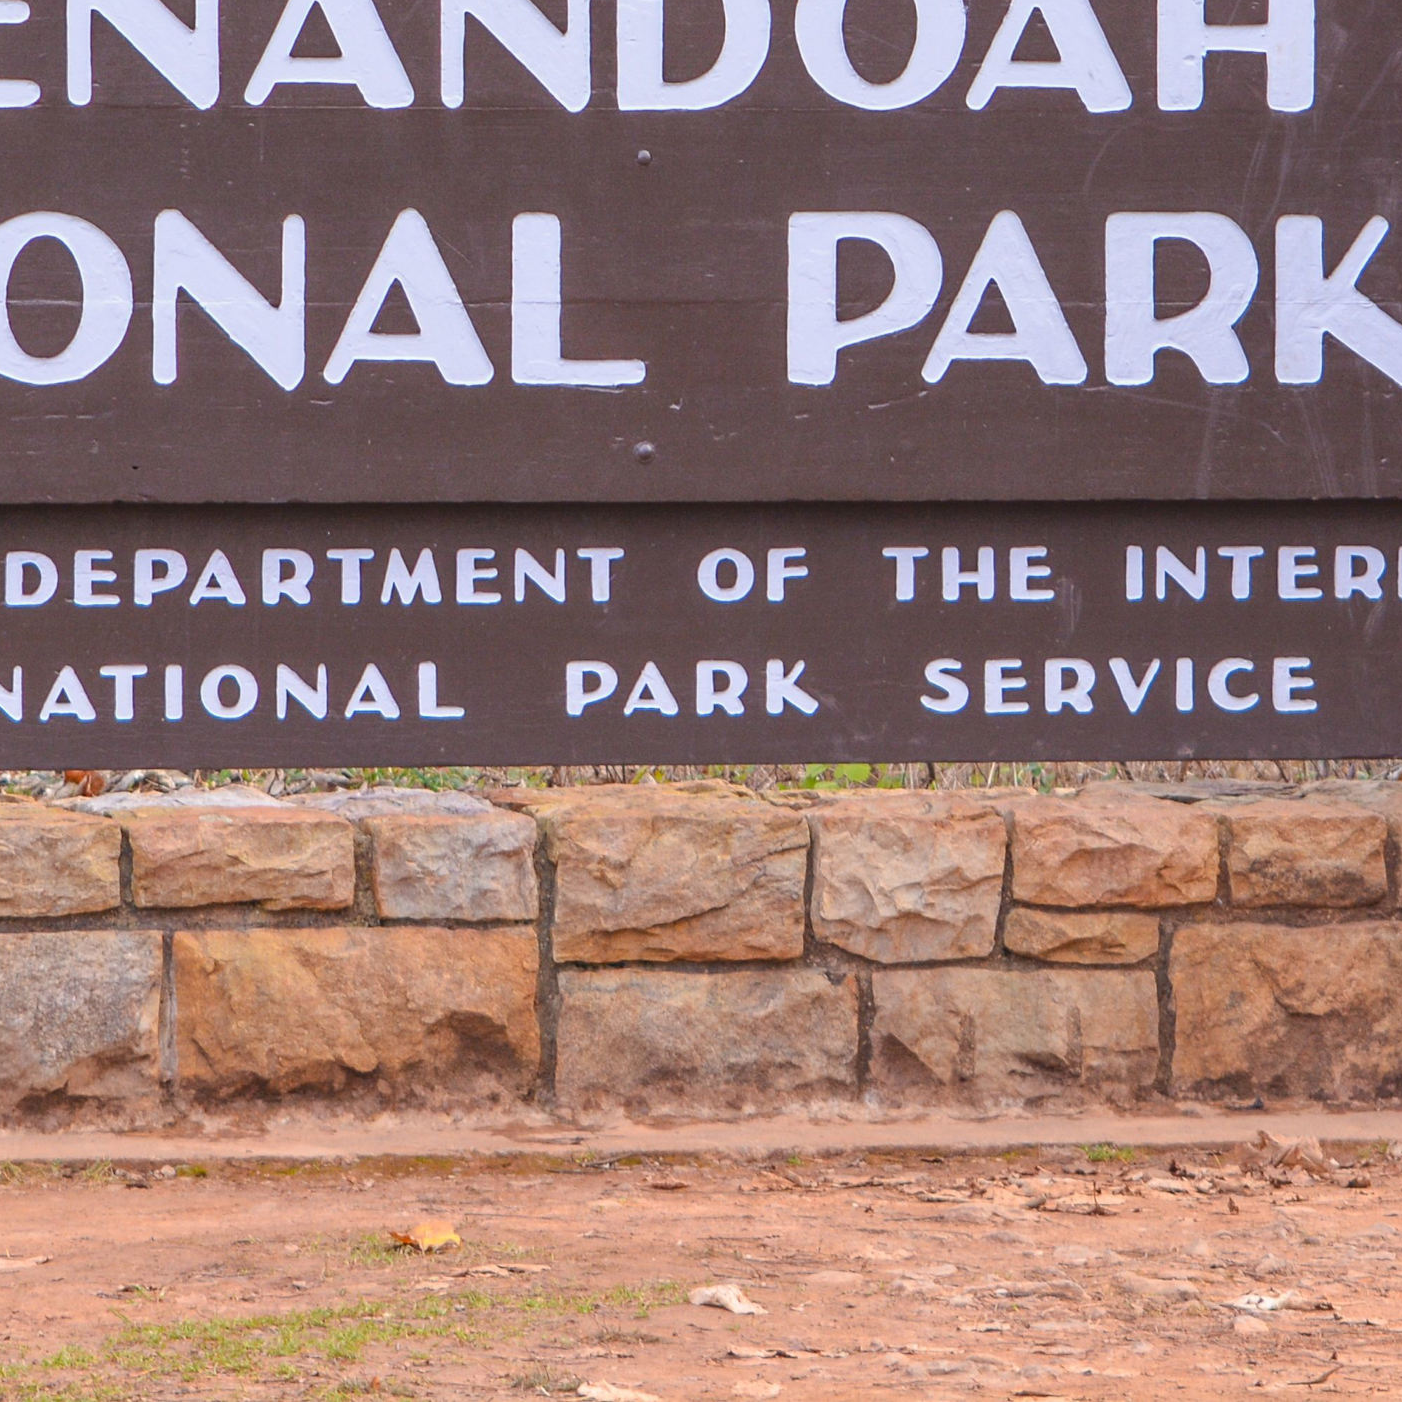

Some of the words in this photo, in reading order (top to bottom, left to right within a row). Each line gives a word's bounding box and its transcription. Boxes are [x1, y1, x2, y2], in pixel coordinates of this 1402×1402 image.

[3, 546, 626, 607] DEPARTMENT
[696, 546, 810, 603] OF
[881, 545, 1056, 602] THE
[564, 658, 820, 717] PARK
[918, 656, 1319, 715] SERVICE
